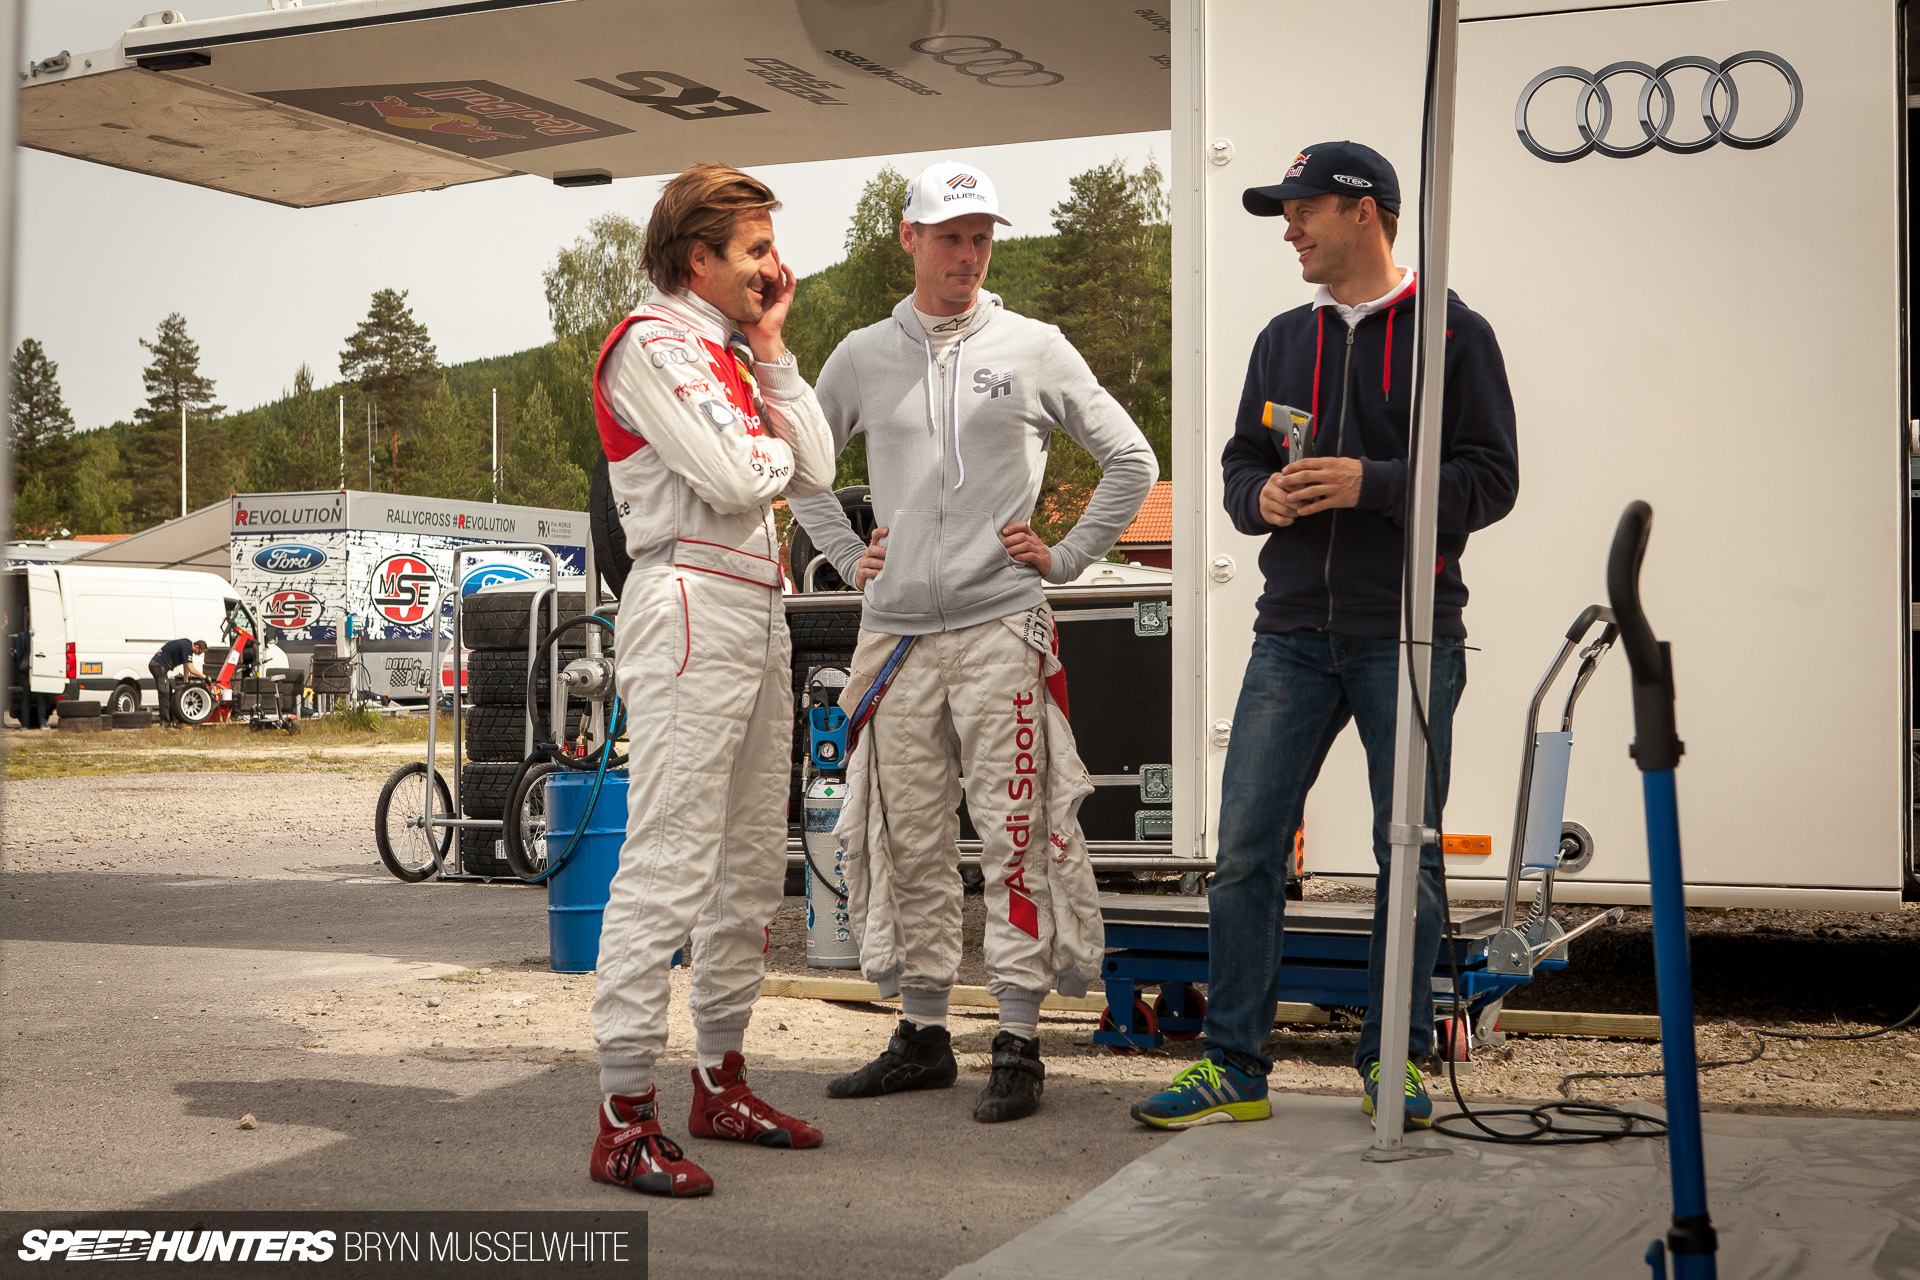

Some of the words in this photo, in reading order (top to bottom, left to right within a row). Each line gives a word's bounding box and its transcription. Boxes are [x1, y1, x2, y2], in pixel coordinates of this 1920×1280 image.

[1339, 176, 1366, 187] CTEK
[972, 367, 1013, 400] SH
[235, 508, 343, 527] REVOLUTION
[386, 508, 451, 528] RALLYCROSS
[452, 513, 517, 533] #REVOLUTION
[266, 548, 312, 570] Ford
[379, 573, 437, 607] MSE
[265, 598, 313, 620] MSE
[385, 658, 413, 670] ROYAL
[1008, 691, 1034, 801] Sport
[1004, 814, 1031, 896] Audi
